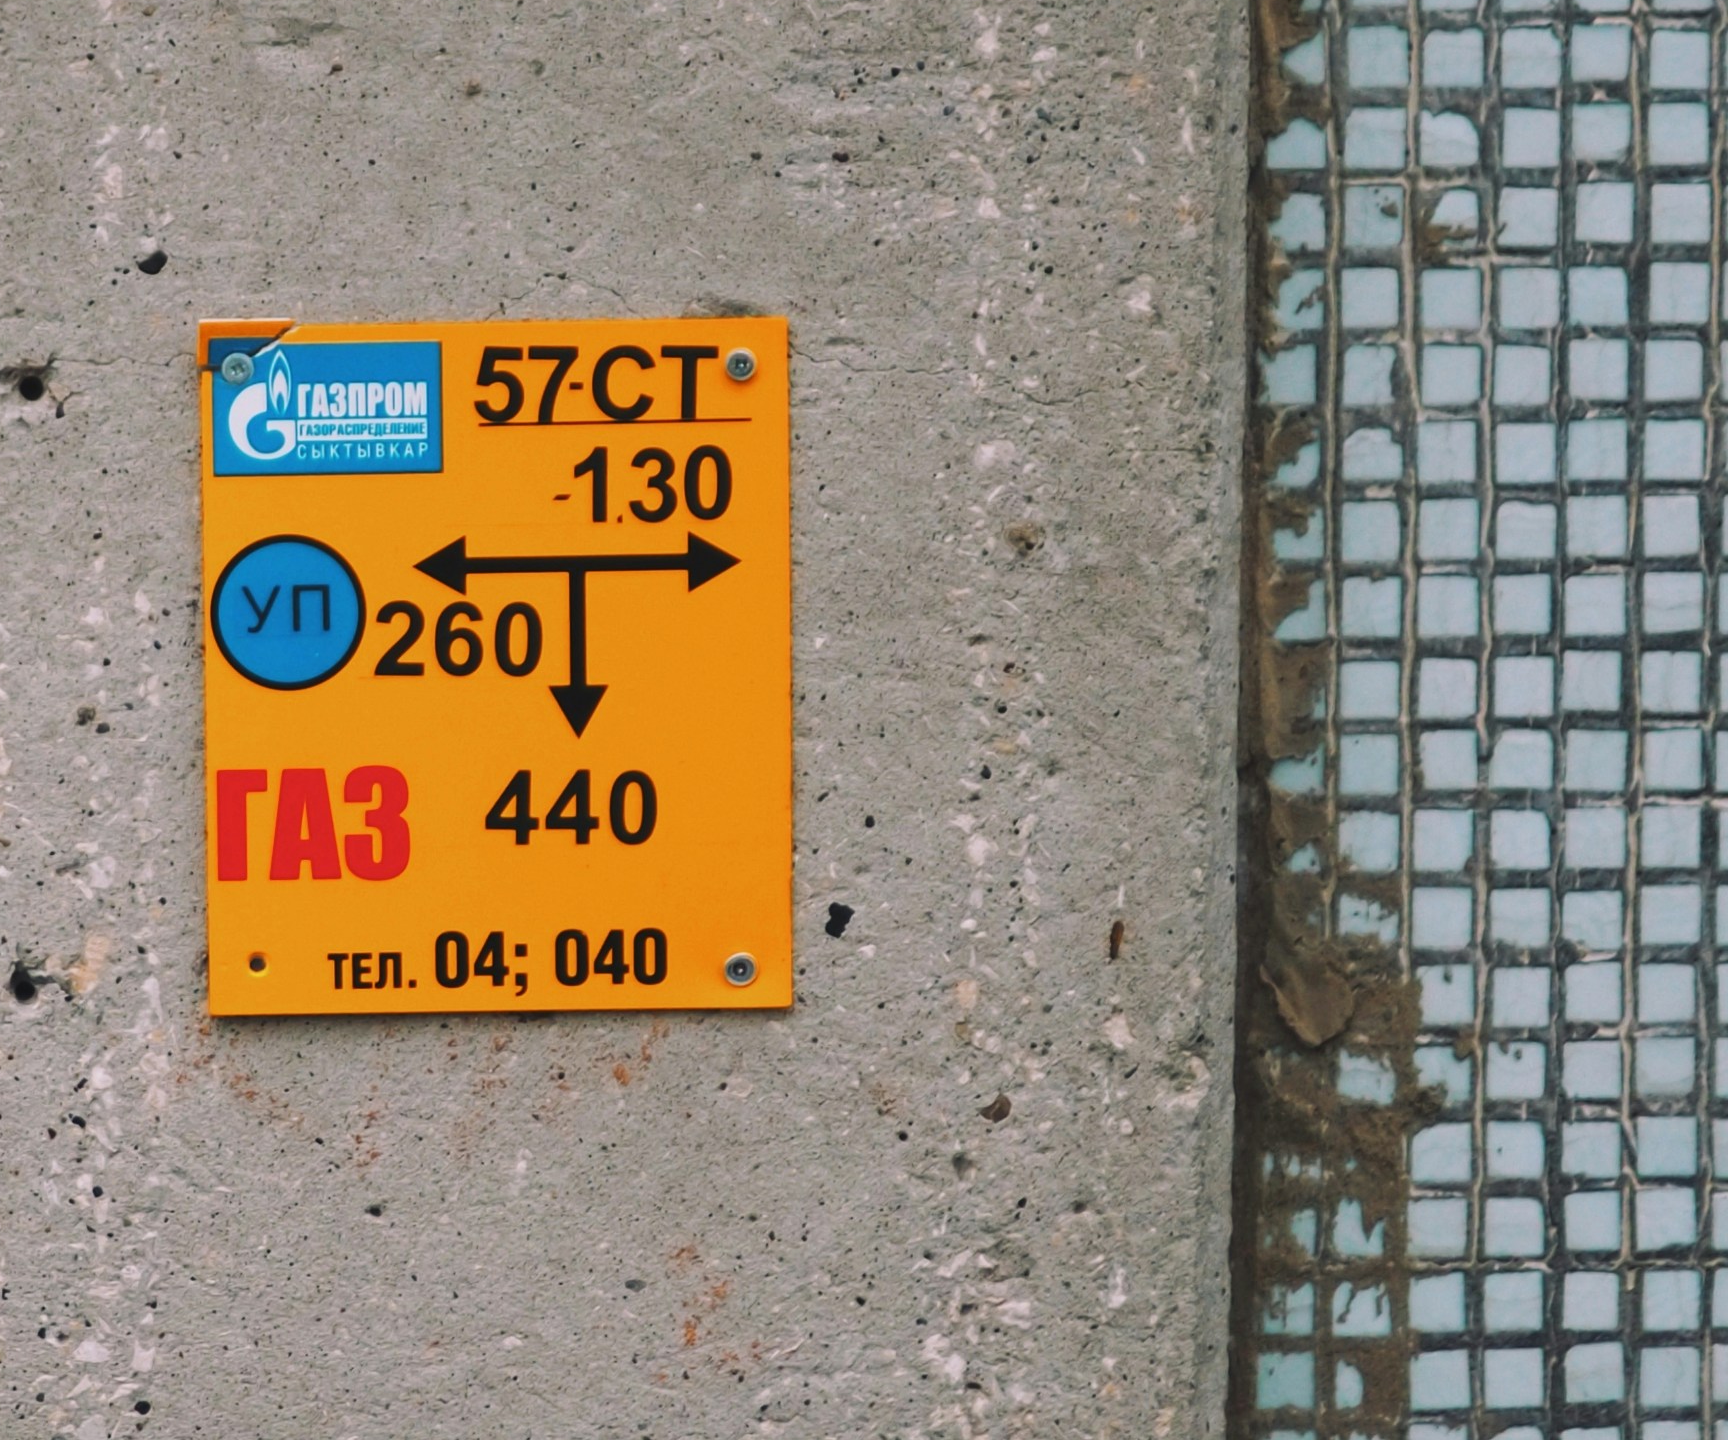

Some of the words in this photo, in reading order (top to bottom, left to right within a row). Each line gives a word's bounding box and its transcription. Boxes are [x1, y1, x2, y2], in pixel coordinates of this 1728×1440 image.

[297, 381, 428, 418] ГАЗПРОМ
[474, 345, 719, 425] 57-СТ
[297, 441, 428, 459] СЫКТЫВКАР
[299, 422, 426, 437] ГАЗОРАСПРЕДЕЛЕНИЕ
[241, 584, 331, 634] УП
[373, 599, 543, 678] 260
[216, 765, 411, 882] ГАЗ
[484, 769, 659, 846] 440
[327, 952, 418, 990] ТЕЛ.
[434, 931, 529, 997] 04;
[554, 928, 669, 987] 040
